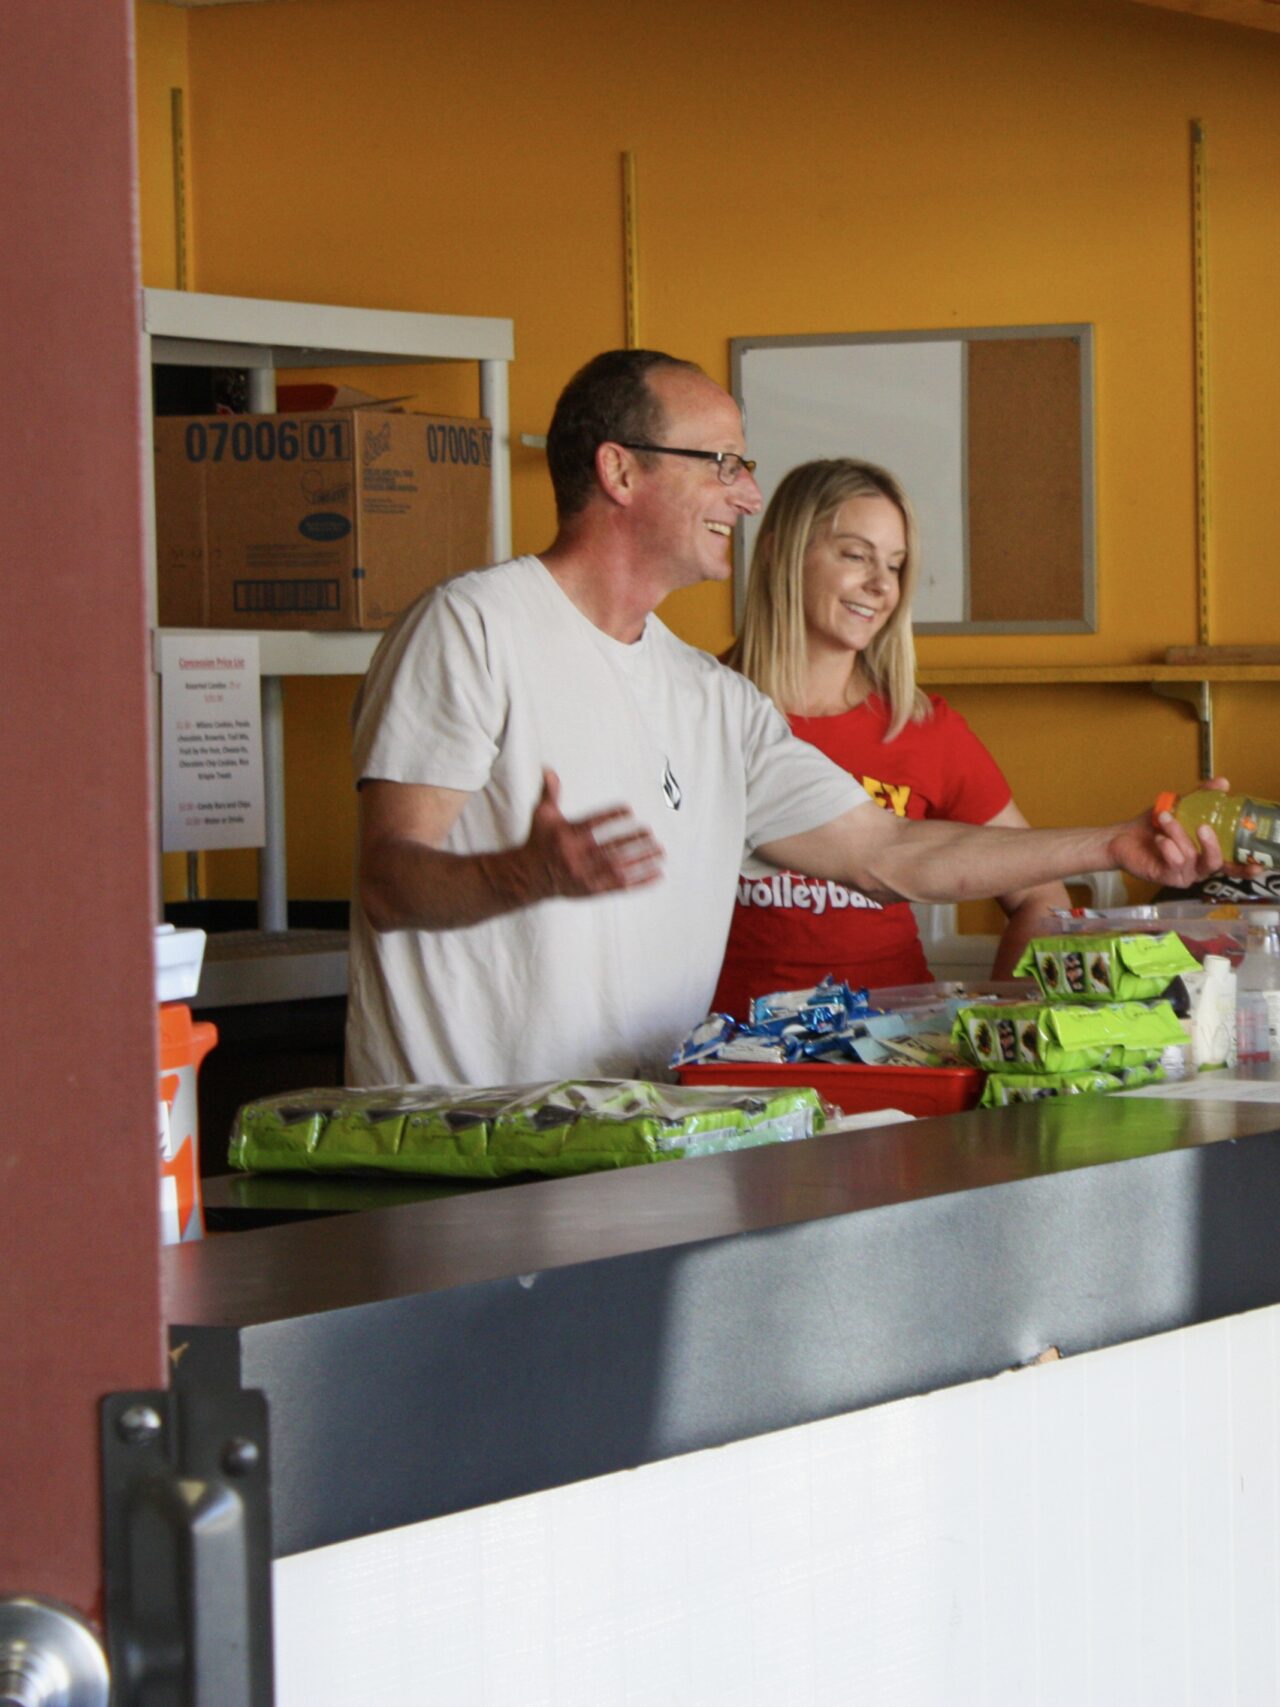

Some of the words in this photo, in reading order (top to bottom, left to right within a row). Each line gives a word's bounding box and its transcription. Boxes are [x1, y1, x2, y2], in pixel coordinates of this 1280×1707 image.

[185, 421, 300, 463] 07006
[307, 423, 346, 460] 01
[427, 424, 480, 465] 07006
[737, 875, 883, 914] volleyba
